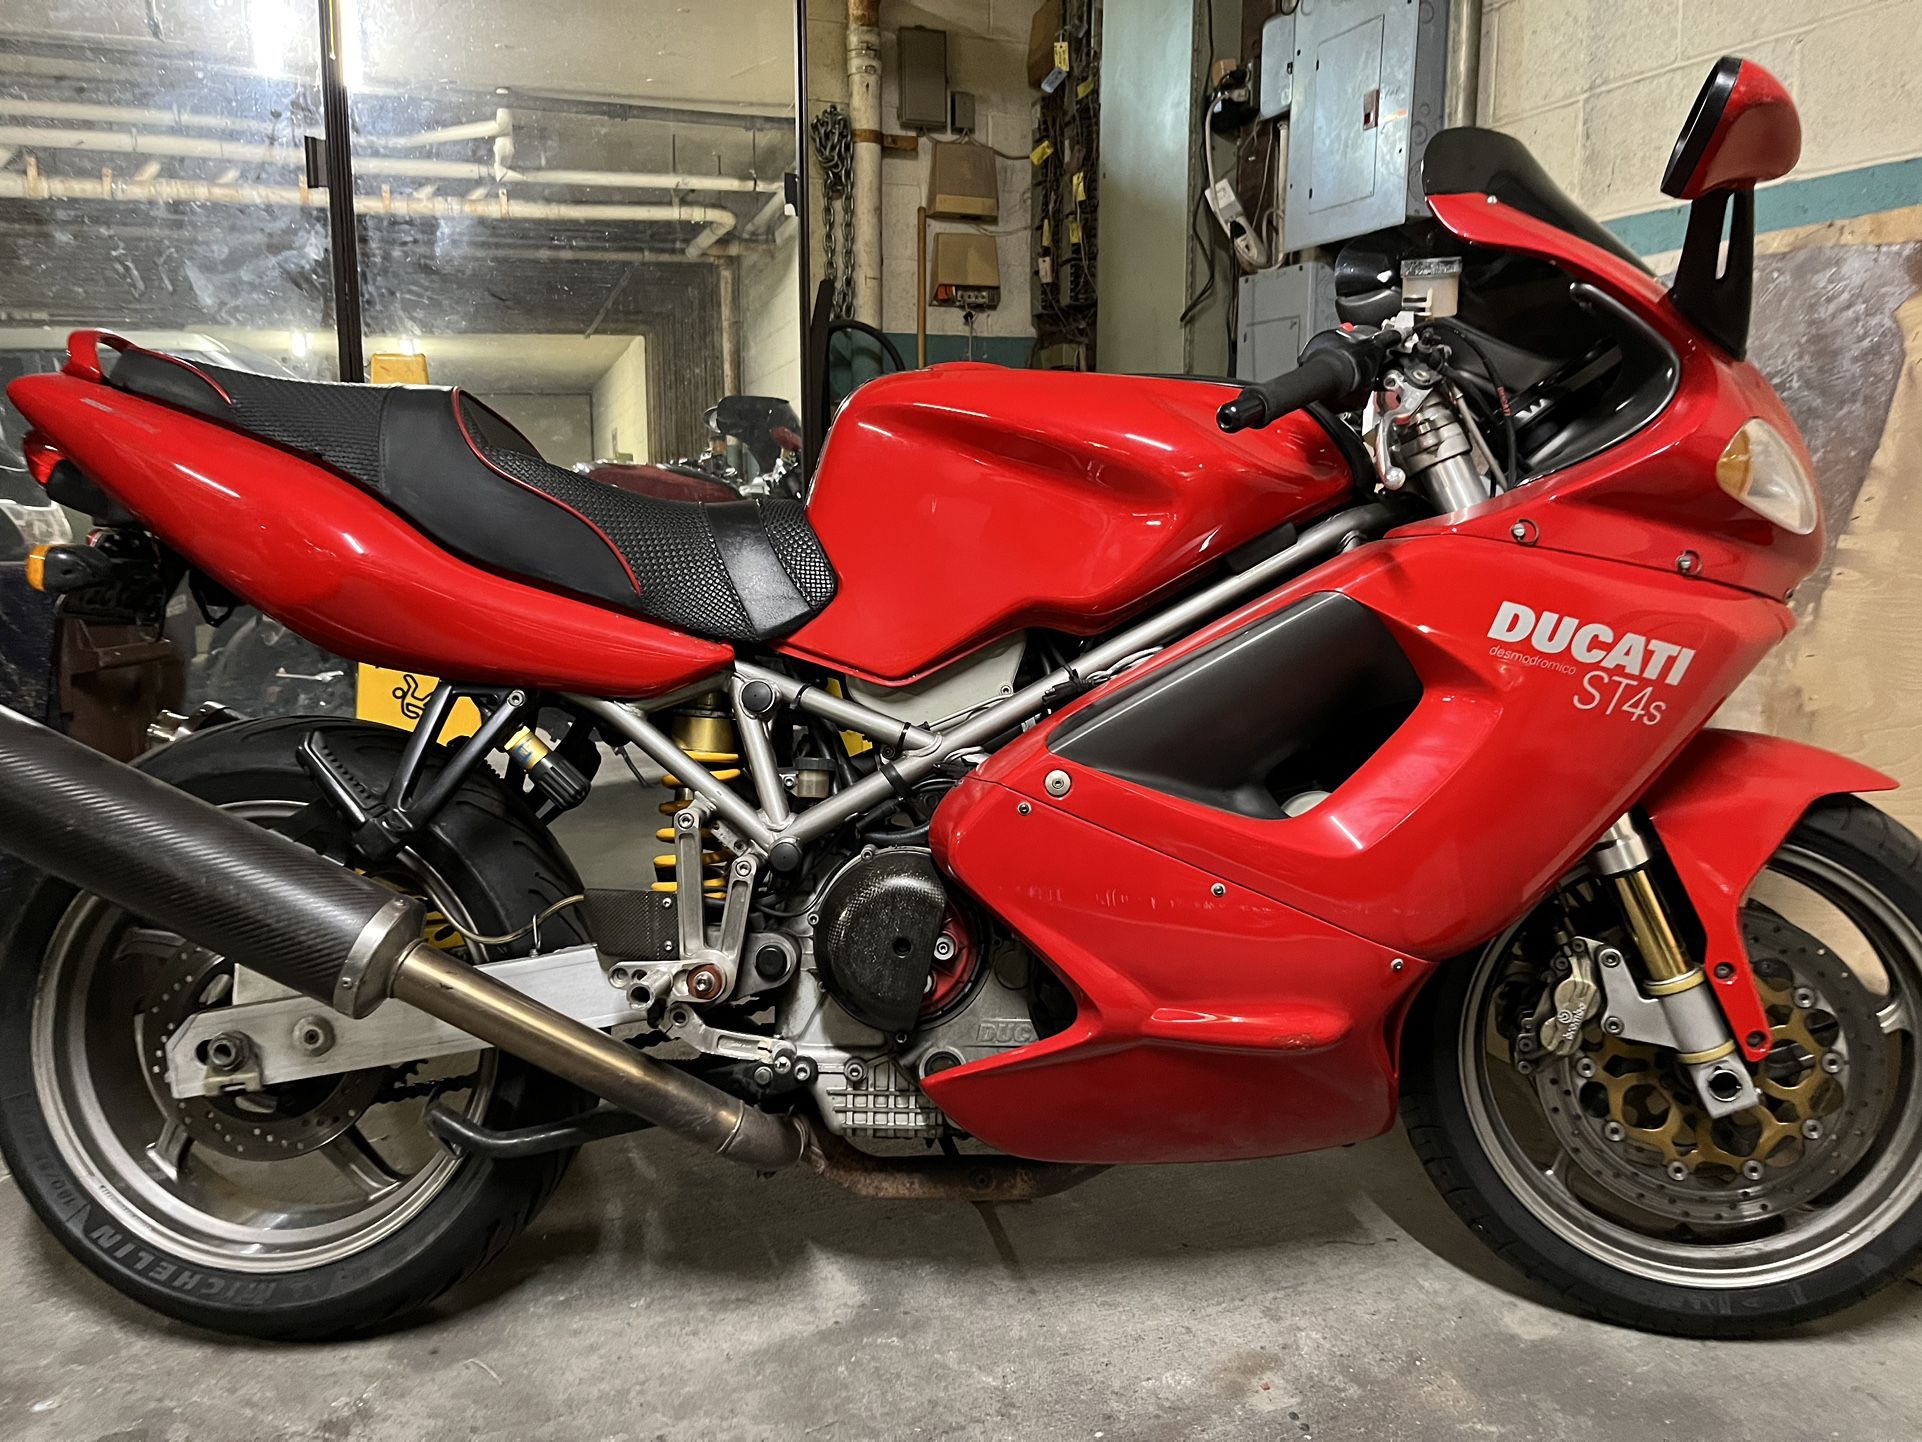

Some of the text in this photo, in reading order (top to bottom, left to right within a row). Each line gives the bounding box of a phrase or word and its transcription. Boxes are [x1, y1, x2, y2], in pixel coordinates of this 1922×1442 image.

[1487, 601, 1696, 686] DUCATI
[1489, 645, 1576, 675] desmodromico
[1573, 671, 1666, 725] ST4s
[976, 1022, 1036, 1042] DUC
[90, 1226, 277, 1304] MICHELIN
